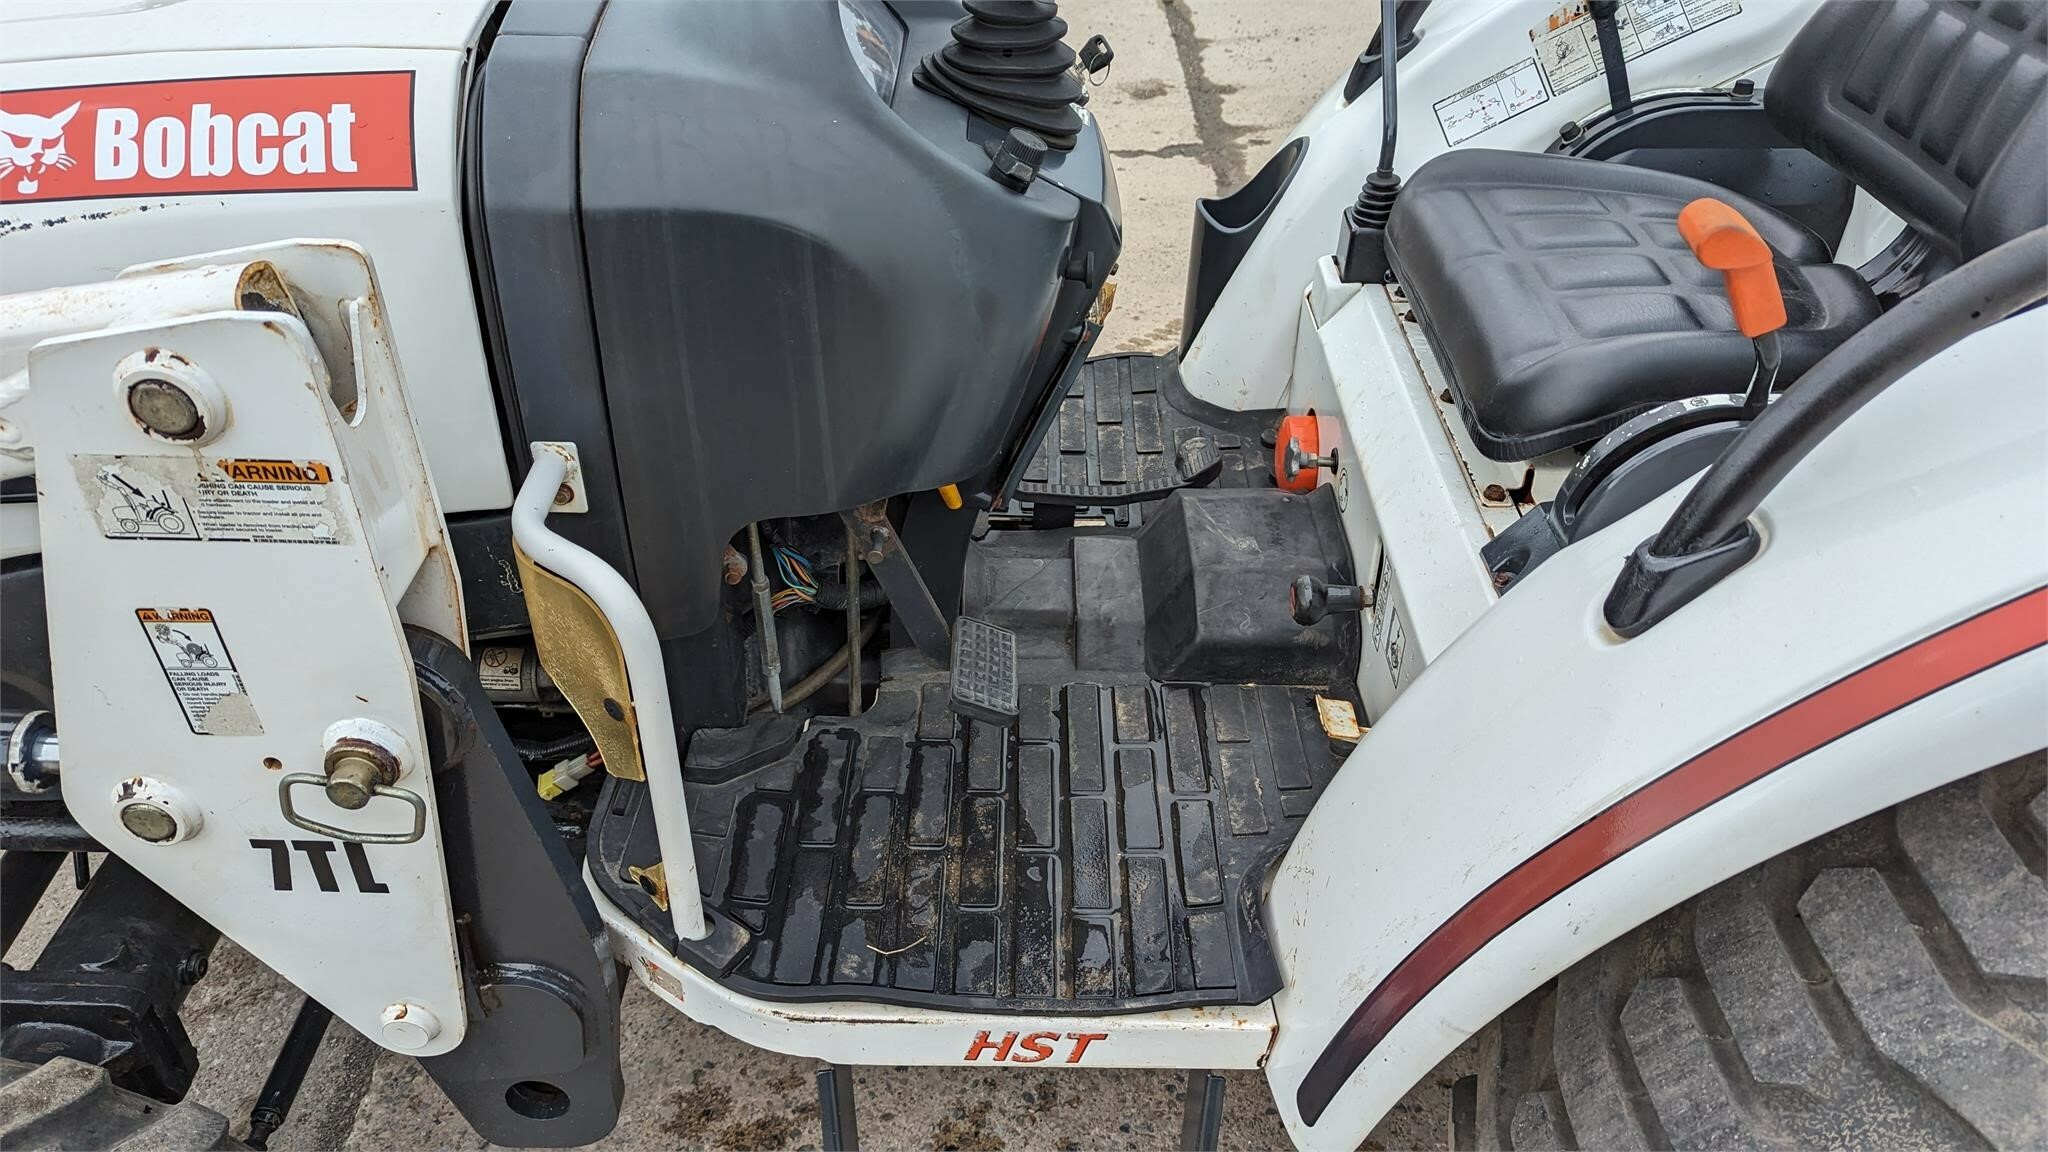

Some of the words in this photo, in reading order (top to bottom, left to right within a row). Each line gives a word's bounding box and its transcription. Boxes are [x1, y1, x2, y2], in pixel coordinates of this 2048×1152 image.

[94, 103, 358, 181] Bobcat
[249, 839, 390, 893] 7TL
[963, 1030, 1109, 1064] HST
